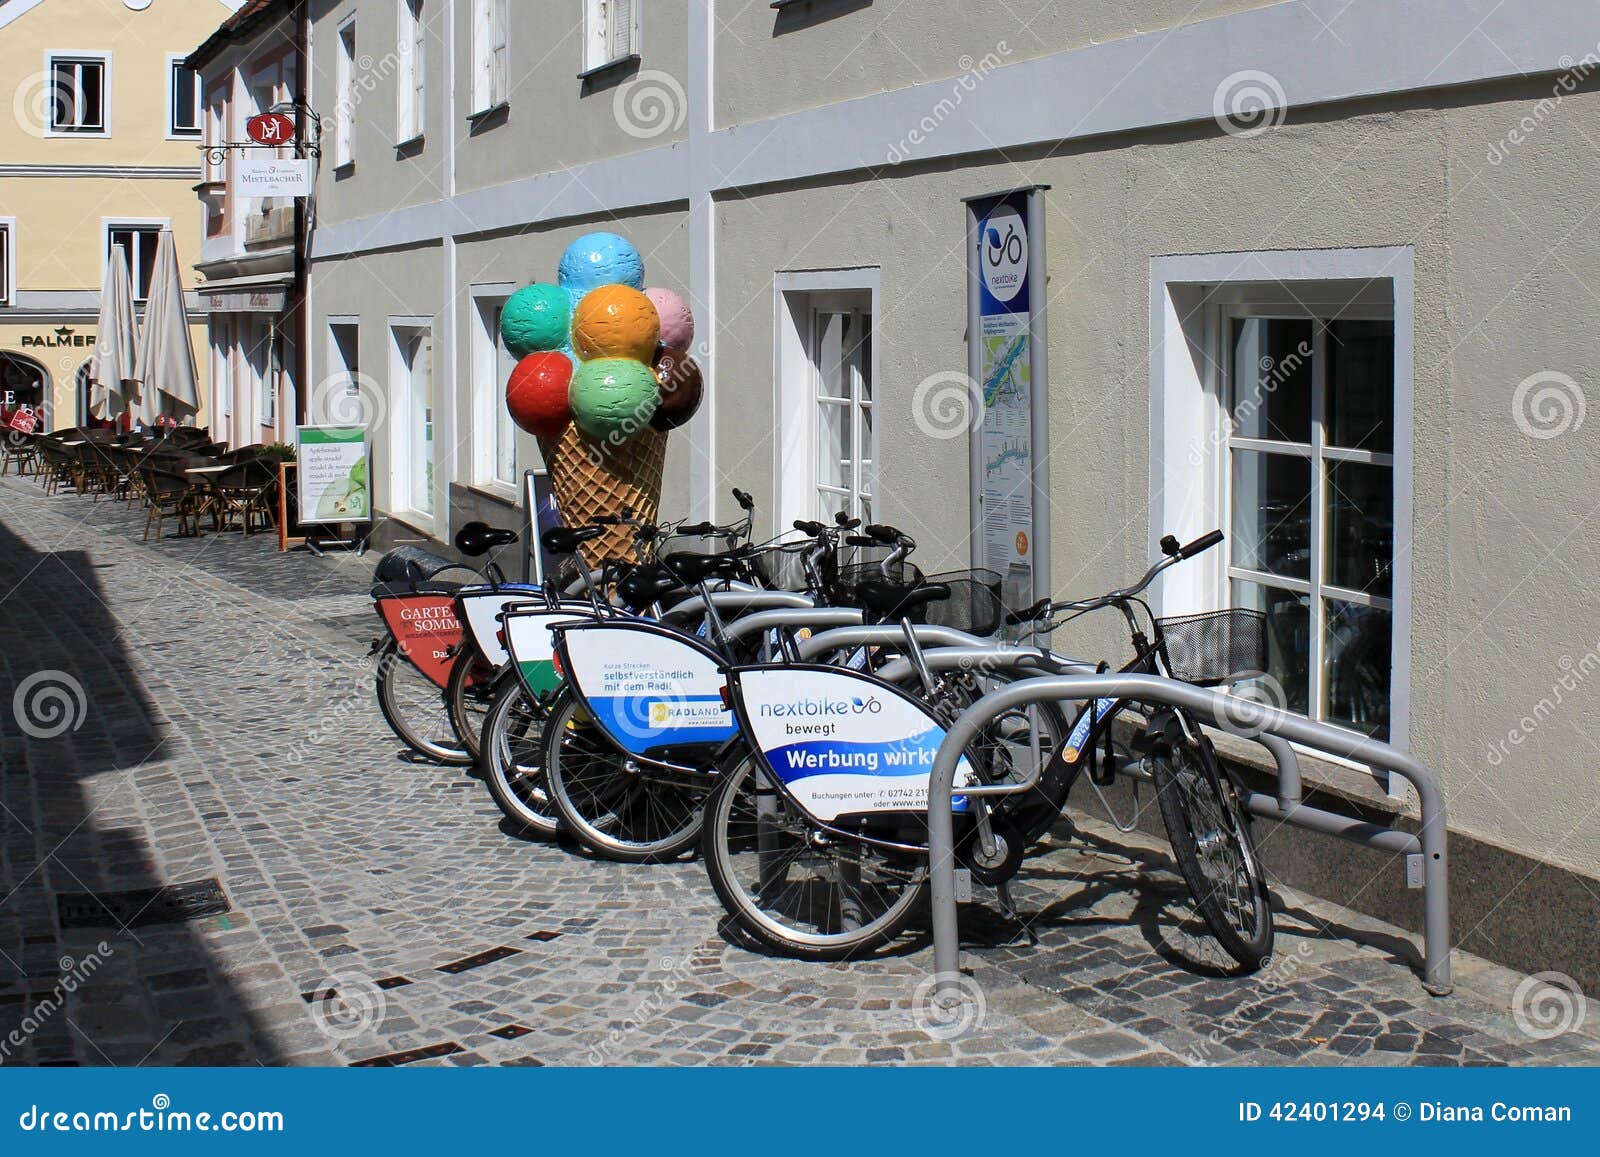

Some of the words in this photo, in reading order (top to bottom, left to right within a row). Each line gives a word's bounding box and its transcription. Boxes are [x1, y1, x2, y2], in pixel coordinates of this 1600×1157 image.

[604, 671, 694, 681] selbstverständlich
[604, 683, 620, 692] mit
[623, 682, 645, 691] dem
[760, 696, 849, 717] nextbike
[668, 708, 720, 717] RADLAND
[786, 723, 836, 737] bewegt
[786, 749, 878, 770] Werbung
[811, 791, 852, 800] Buchungen
[854, 791, 876, 799] unter:
[888, 789, 914, 798] 02742
